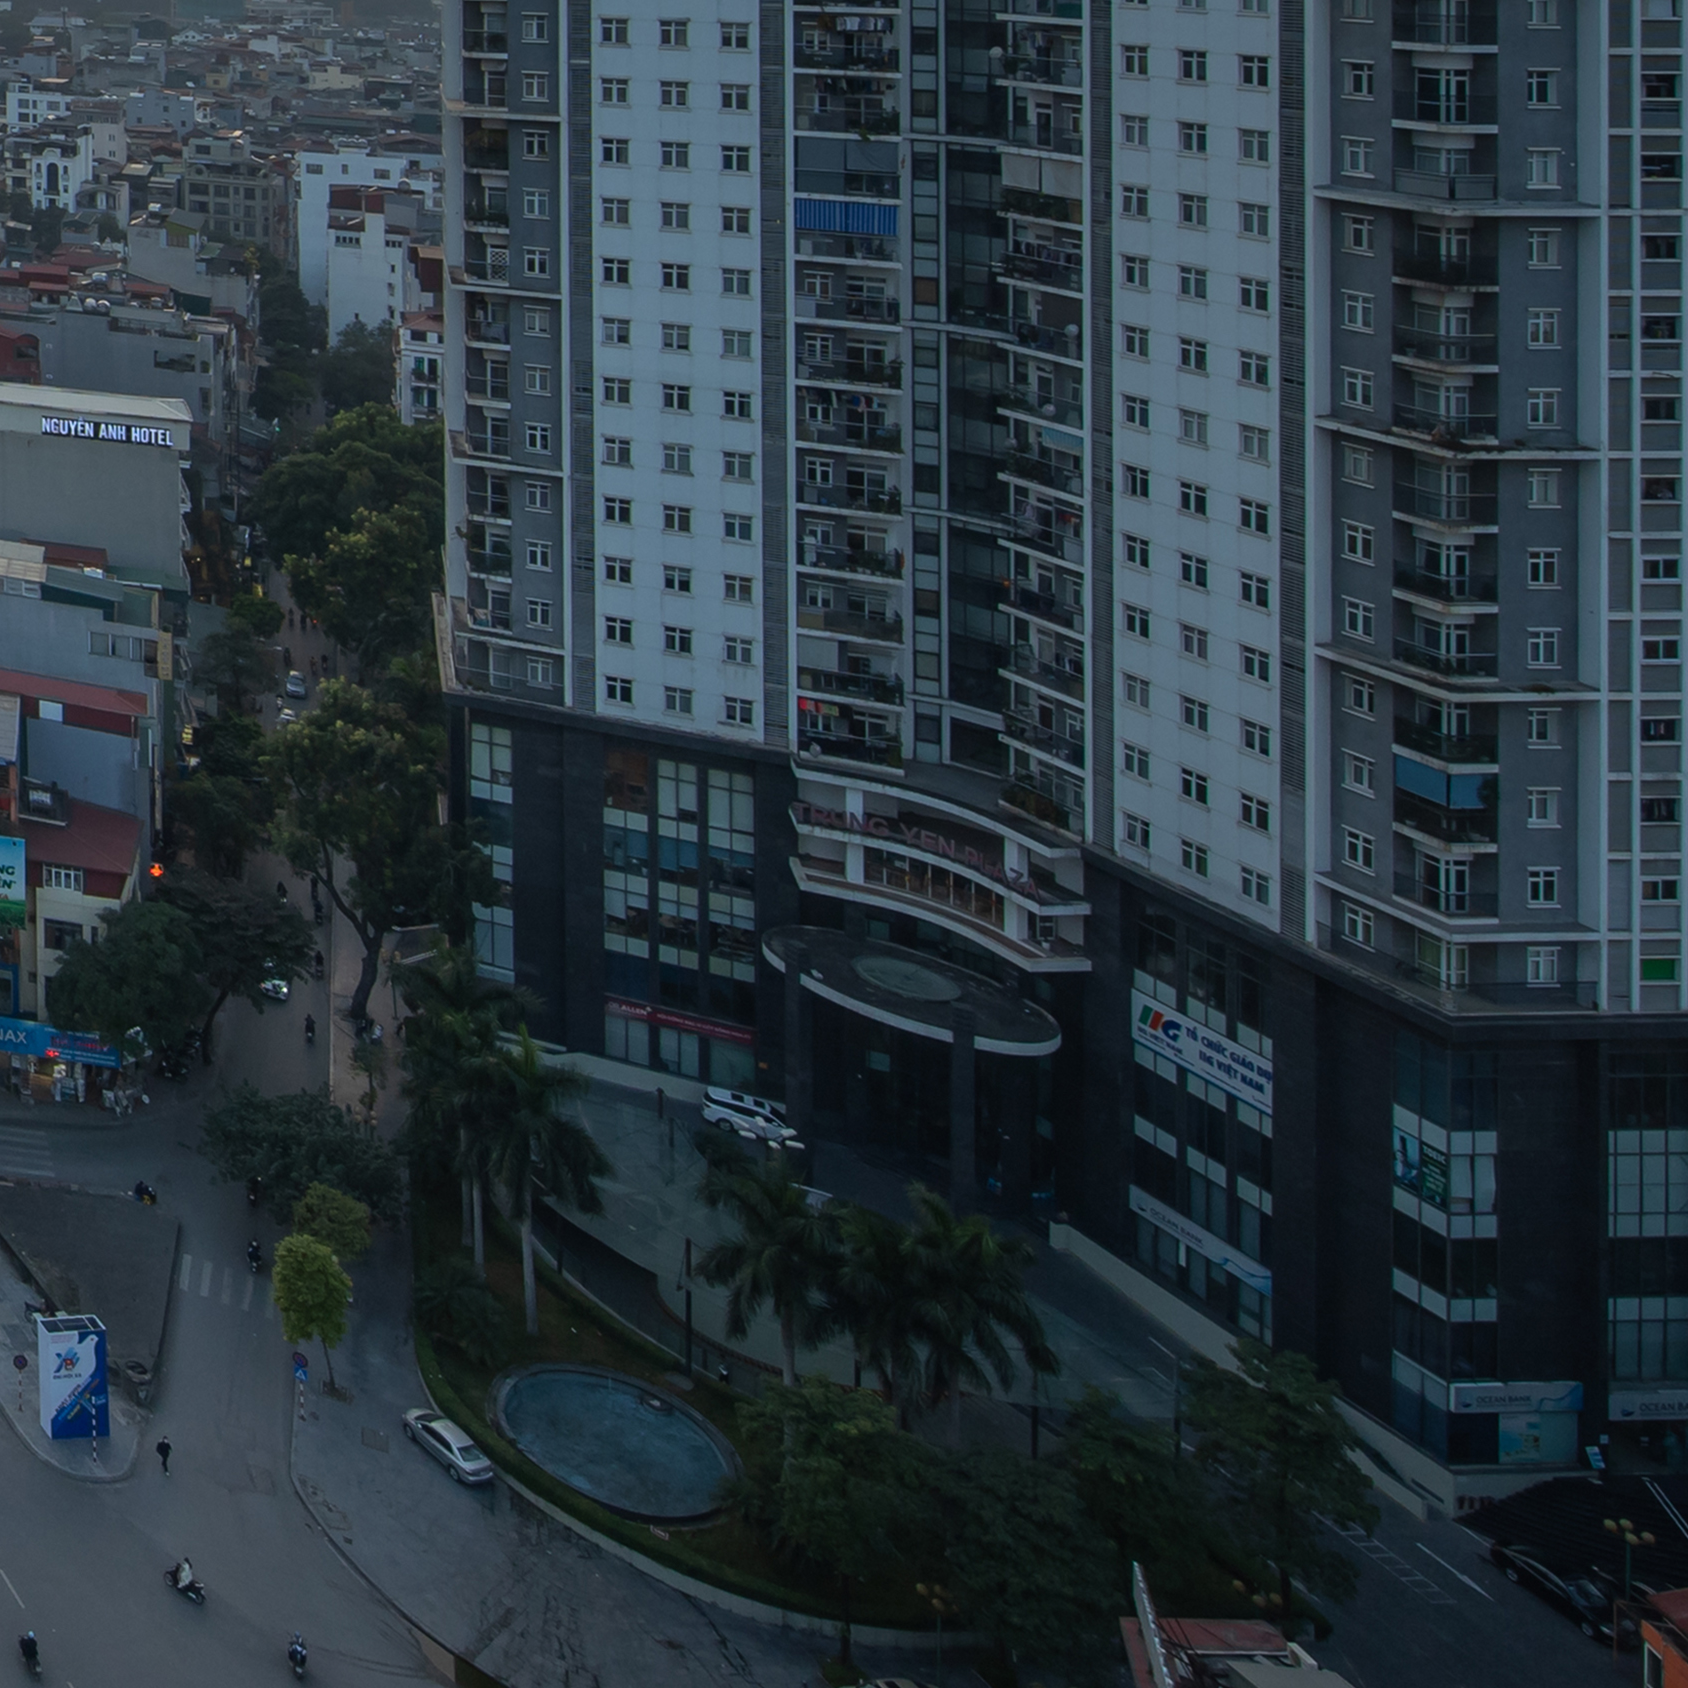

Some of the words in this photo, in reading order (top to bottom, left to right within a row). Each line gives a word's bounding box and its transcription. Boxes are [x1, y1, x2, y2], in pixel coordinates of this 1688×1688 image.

[99, 424, 126, 441] ANH
[131, 427, 174, 446] HOTEL
[792, 801, 889, 838] TRUNG
[899, 822, 955, 859] YEN
[965, 845, 1041, 902] PLAZA
[1201, 1035, 1229, 1058] CHỨC
[1230, 1052, 1255, 1072] GIÁO
[1216, 1060, 1238, 1080] VIỆT
[1240, 1073, 1265, 1094] NAM
[1150, 1207, 1179, 1231] OCEAN
[1179, 1227, 1204, 1246] BANK
[1476, 1396, 1507, 1404] OCEAN
[1508, 1395, 1532, 1403] BANK
[1639, 1402, 1675, 1412] OCEAN
